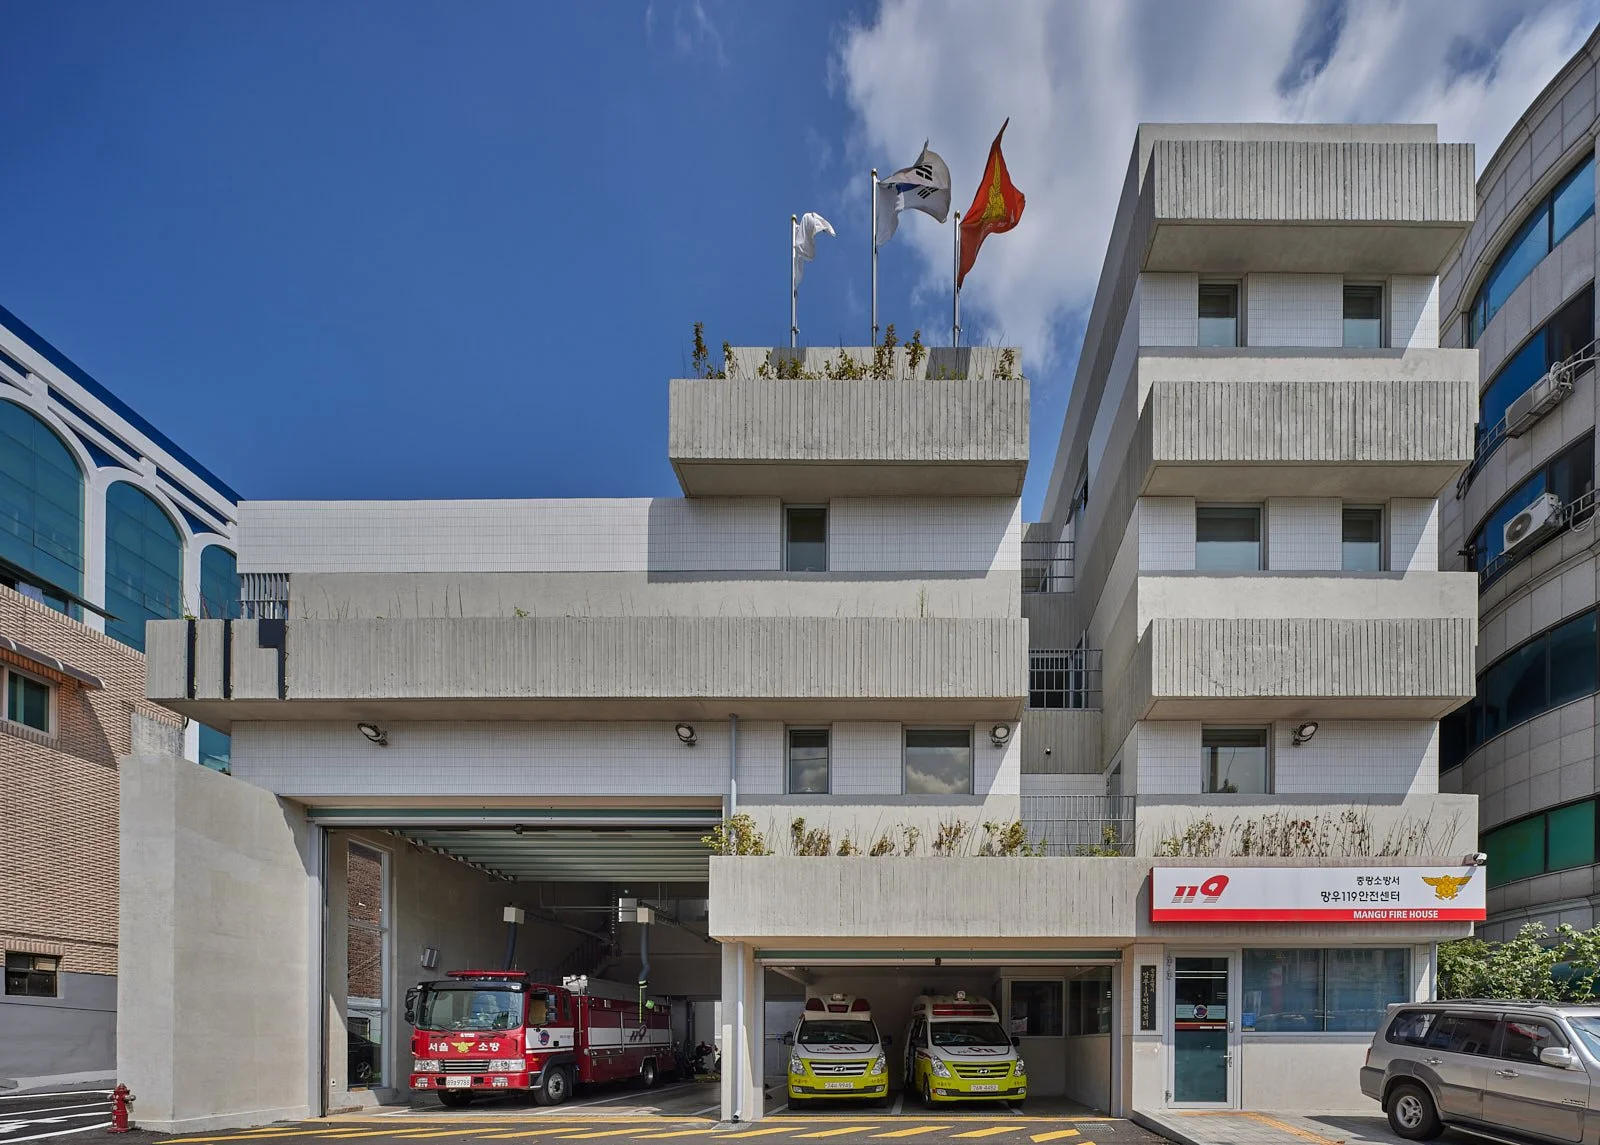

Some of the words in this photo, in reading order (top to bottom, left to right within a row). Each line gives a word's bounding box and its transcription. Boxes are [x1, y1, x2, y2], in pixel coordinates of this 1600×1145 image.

[1356, 876, 1400, 886] 중랑소방서
[1171, 875, 1230, 903] 119
[1320, 891, 1400, 903] 망우119안전센터
[1353, 910, 1387, 919] MANGU
[1389, 910, 1408, 919] FIRE
[1409, 910, 1439, 919] HOUSE
[628, 1025, 648, 1042] 119
[428, 1042, 449, 1052] 서울
[478, 1042, 500, 1052] 소방
